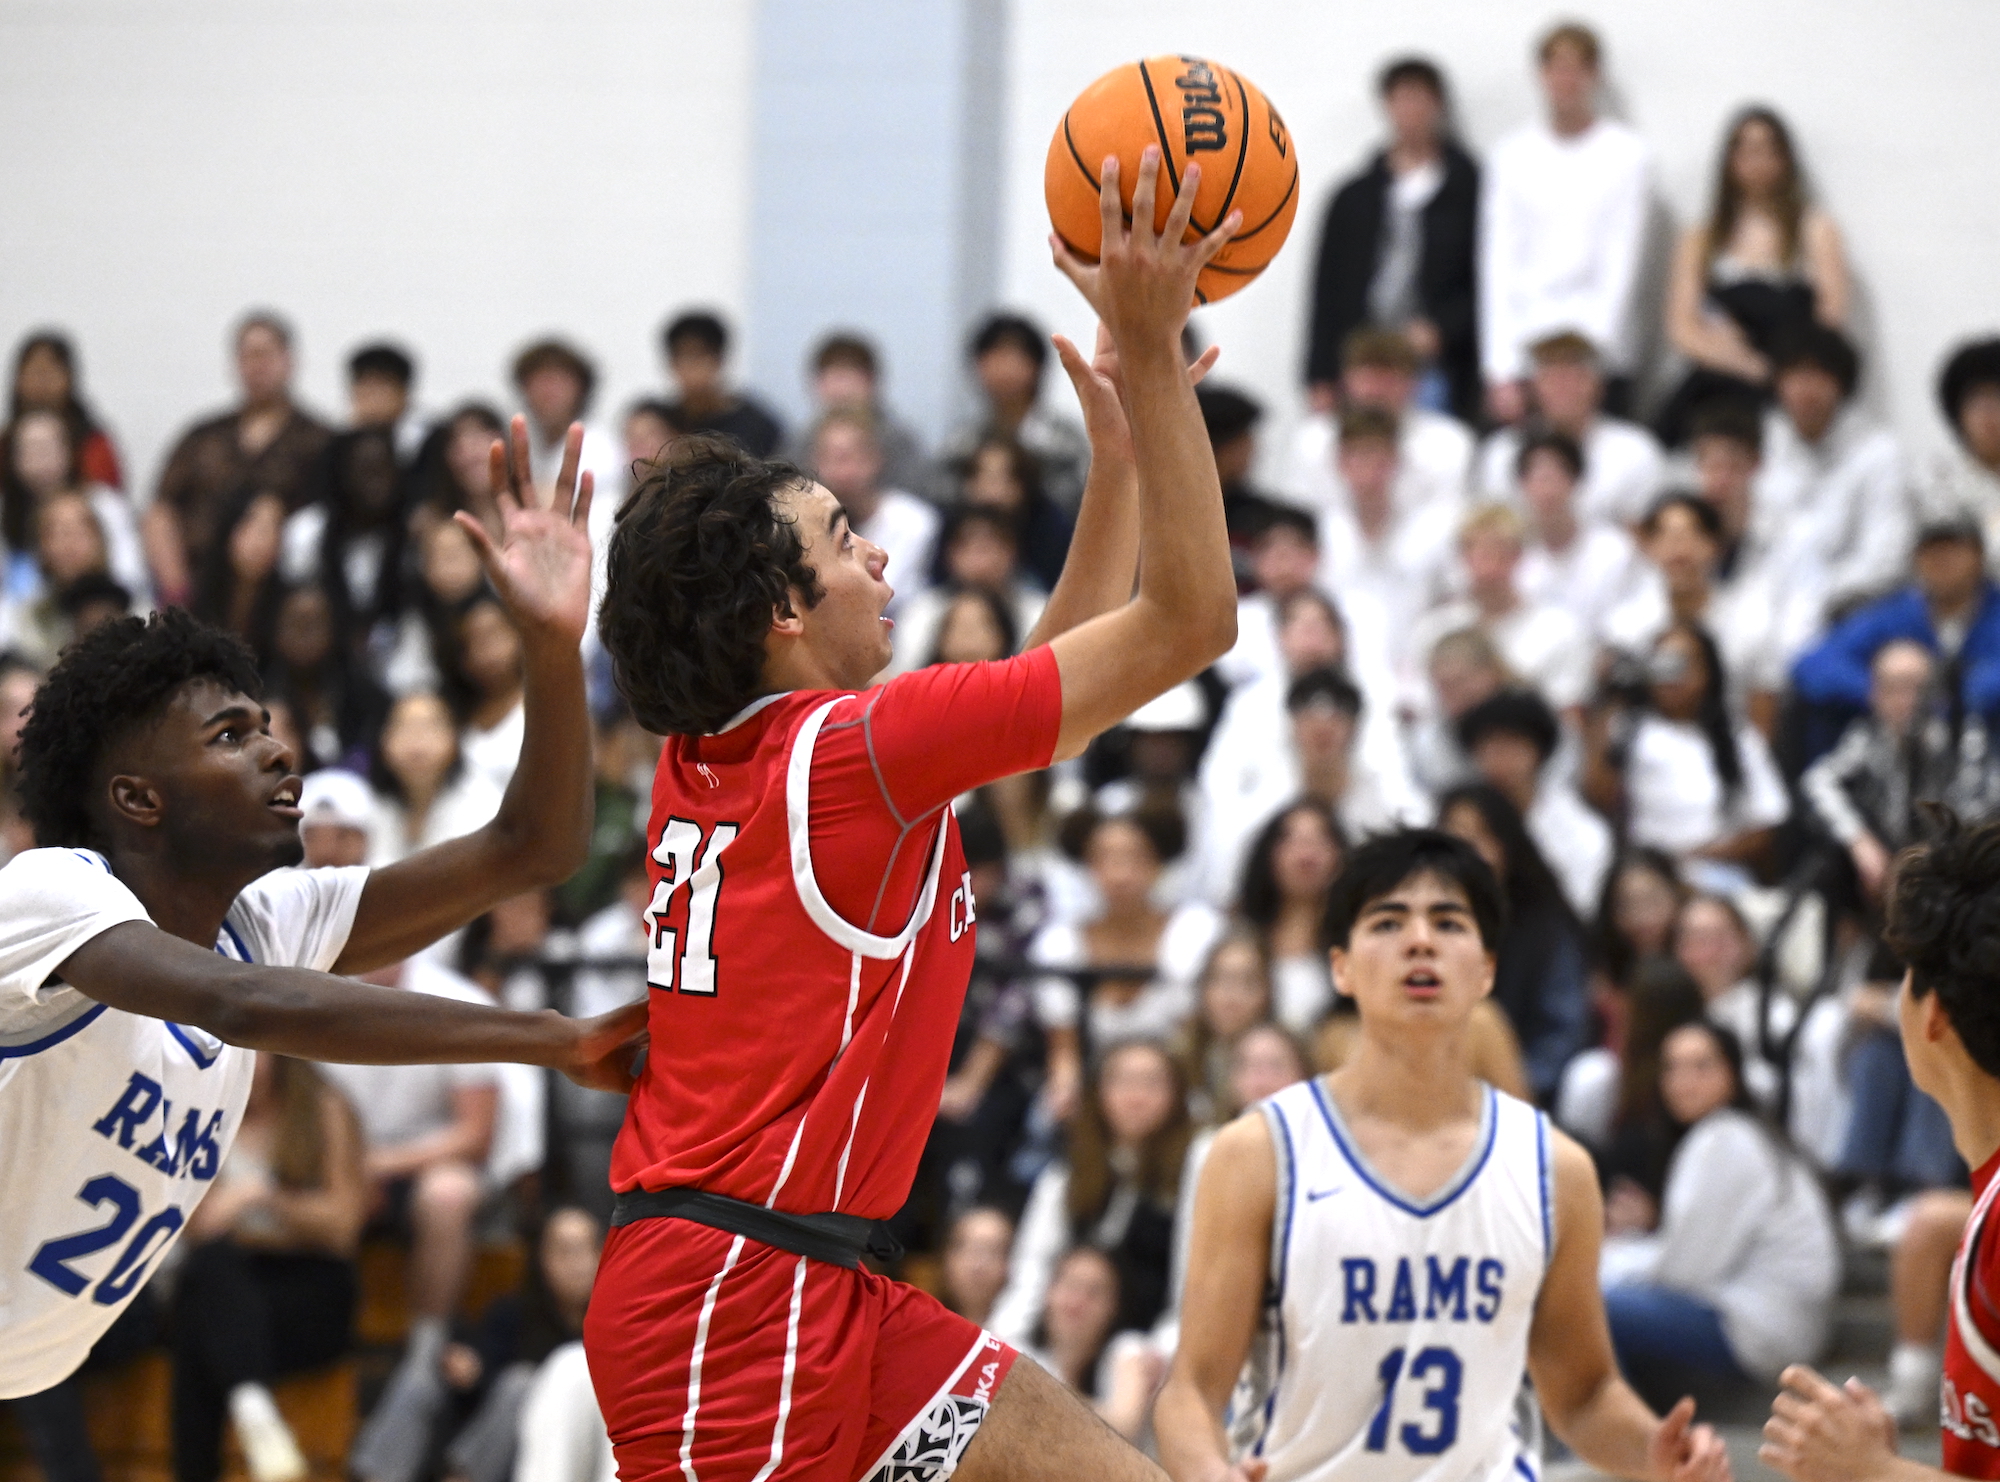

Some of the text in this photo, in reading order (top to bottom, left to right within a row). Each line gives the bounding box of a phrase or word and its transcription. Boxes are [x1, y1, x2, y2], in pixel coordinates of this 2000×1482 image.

[644, 814, 740, 998] 21
[92, 1069, 224, 1181] RAMS
[24, 1171, 185, 1307] 20
[1340, 1254, 1505, 1324] RAMS
[1364, 1345, 1464, 1456] 13
